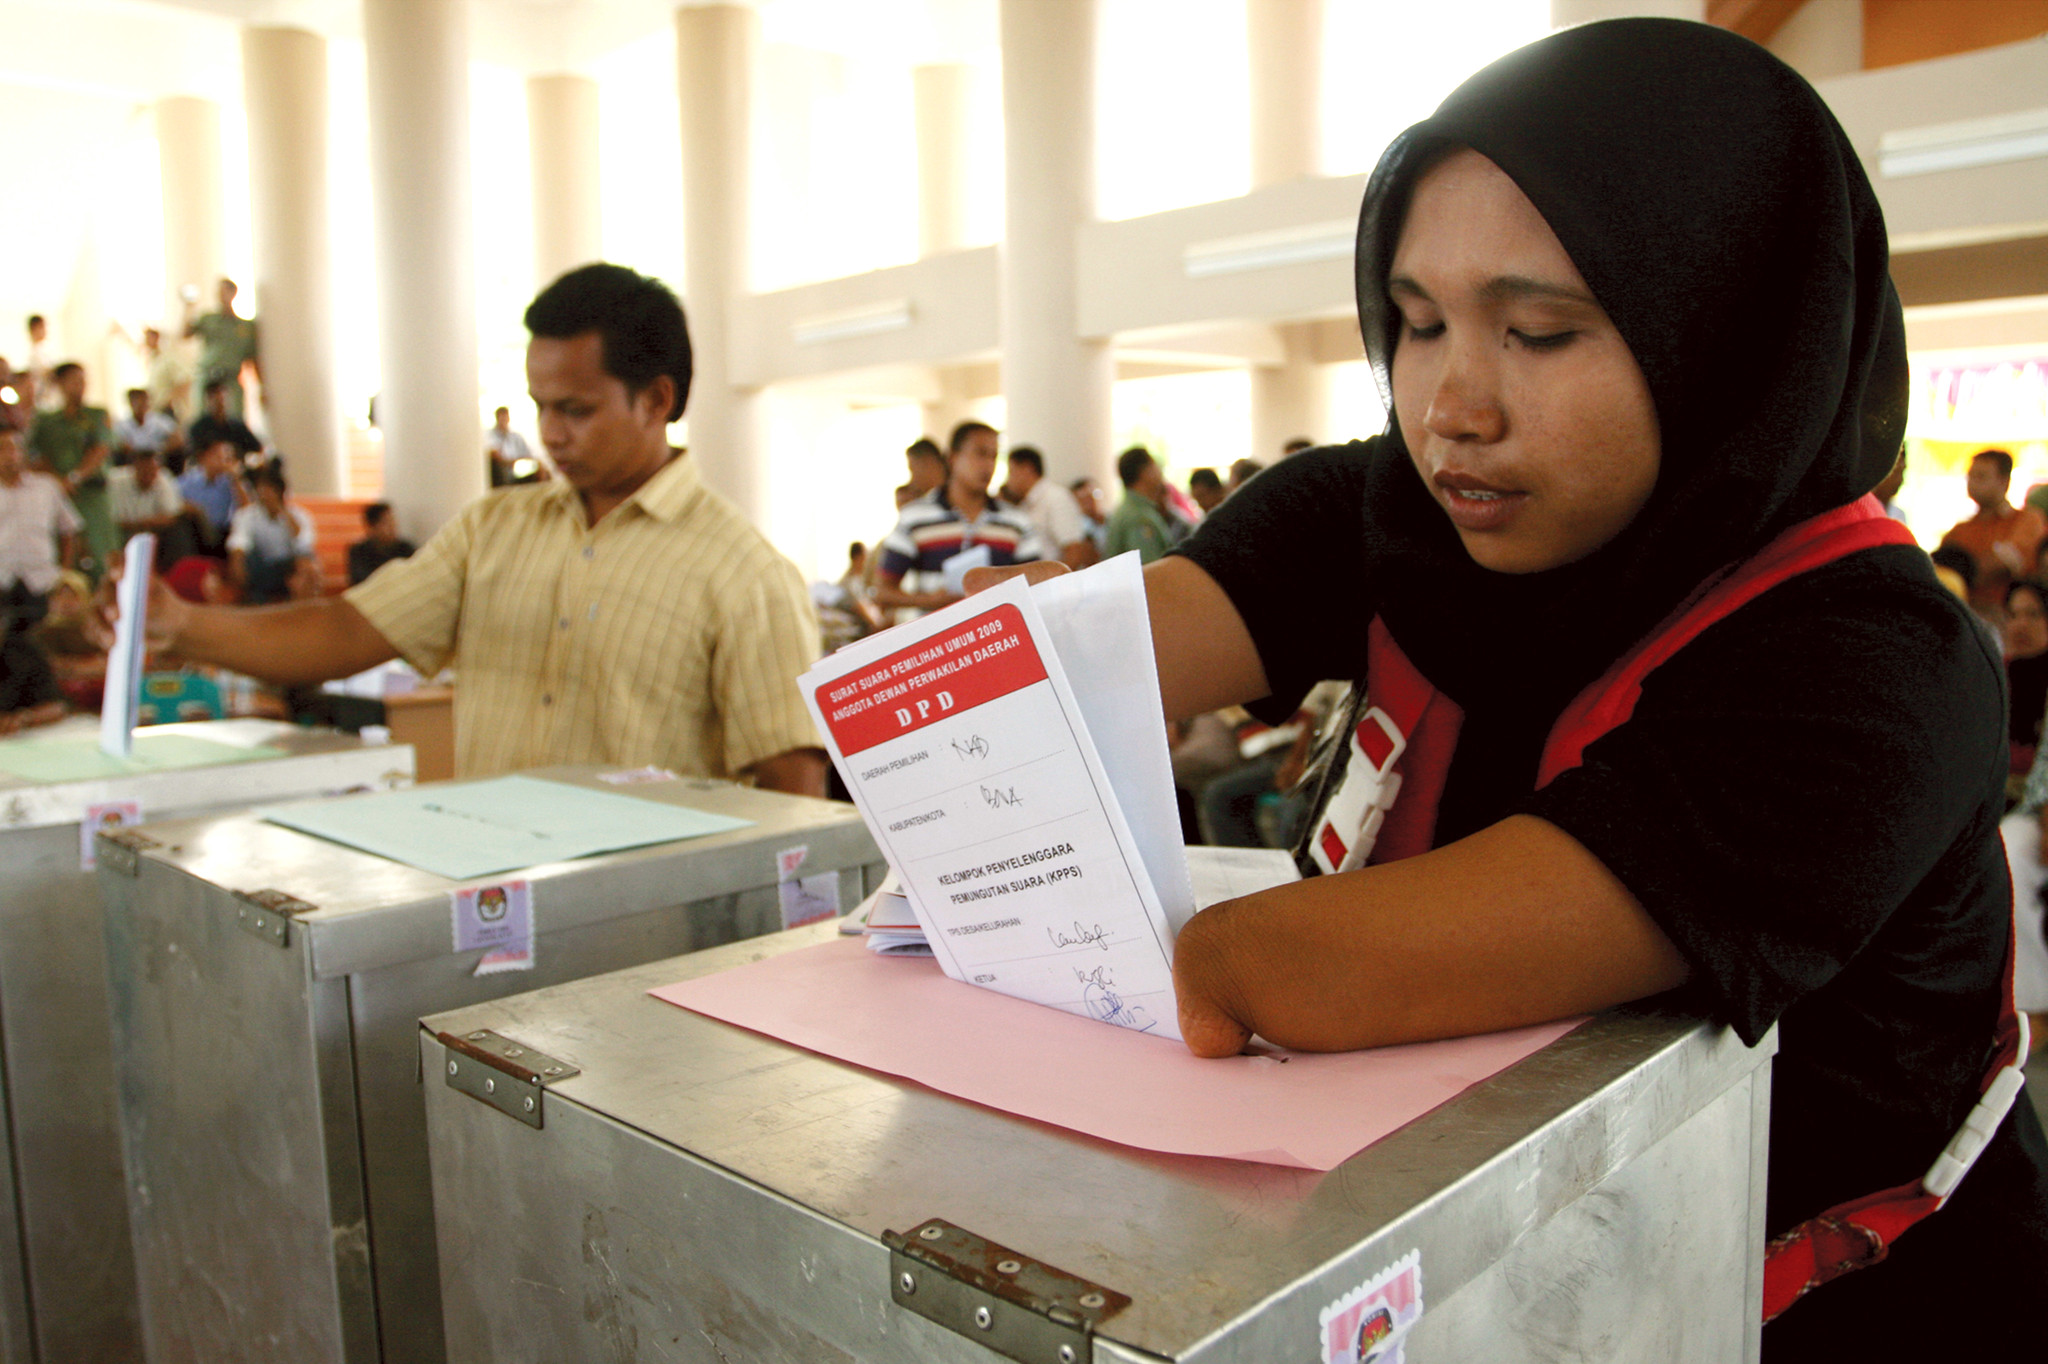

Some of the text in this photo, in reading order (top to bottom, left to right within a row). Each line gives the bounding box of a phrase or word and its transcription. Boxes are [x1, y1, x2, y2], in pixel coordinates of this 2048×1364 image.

[829, 619, 1003, 703] SURAT SUARA PEMILIHAN UMUM 2009
[832, 634, 1020, 722] ANGGOTA DEWAN PERWAKILAN DAERAH
[861, 750, 929, 781] DAERAH PEMILIHAN
[937, 842, 1075, 886] KELOMPOK PENYELENGGARA
[950, 865, 1083, 904] PEMUNGUTAN SUARA (KPPS)
[974, 973, 997, 985] KETUA
